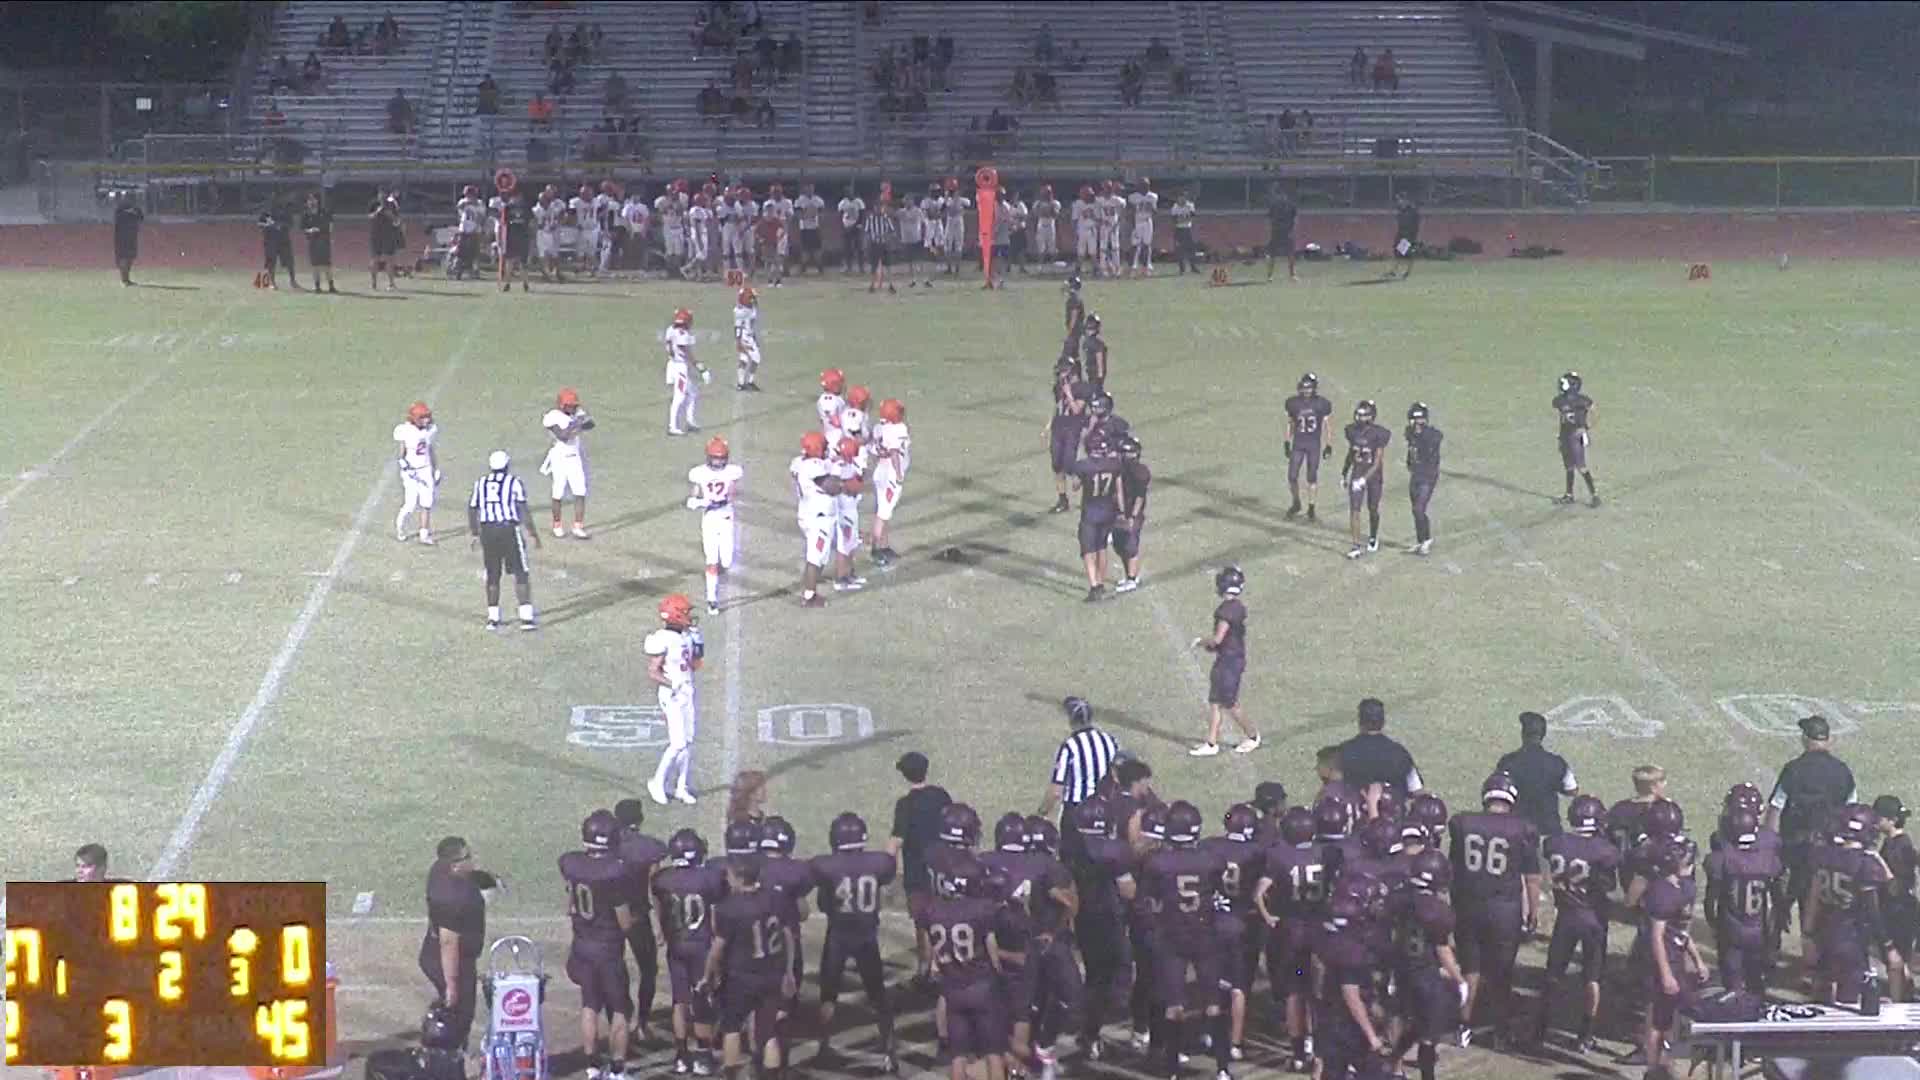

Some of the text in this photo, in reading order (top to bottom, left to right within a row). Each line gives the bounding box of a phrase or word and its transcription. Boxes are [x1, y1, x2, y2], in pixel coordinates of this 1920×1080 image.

[254, 272, 270, 288] 40
[1092, 472, 1114, 497] 17
[1463, 833, 1510, 876] 66
[834, 875, 878, 913] 40
[1175, 875, 1201, 913] 5
[1288, 864, 1325, 902] 15
[1730, 879, 1767, 917] 16
[110, 883, 209, 942] 8 29
[281, 924, 313, 985] 0
[750, 914, 784, 960] 12
[158, 950, 185, 1001] 2
[230, 956, 251, 997] 3
[102, 998, 133, 1061] 3
[255, 998, 310, 1061] 45
